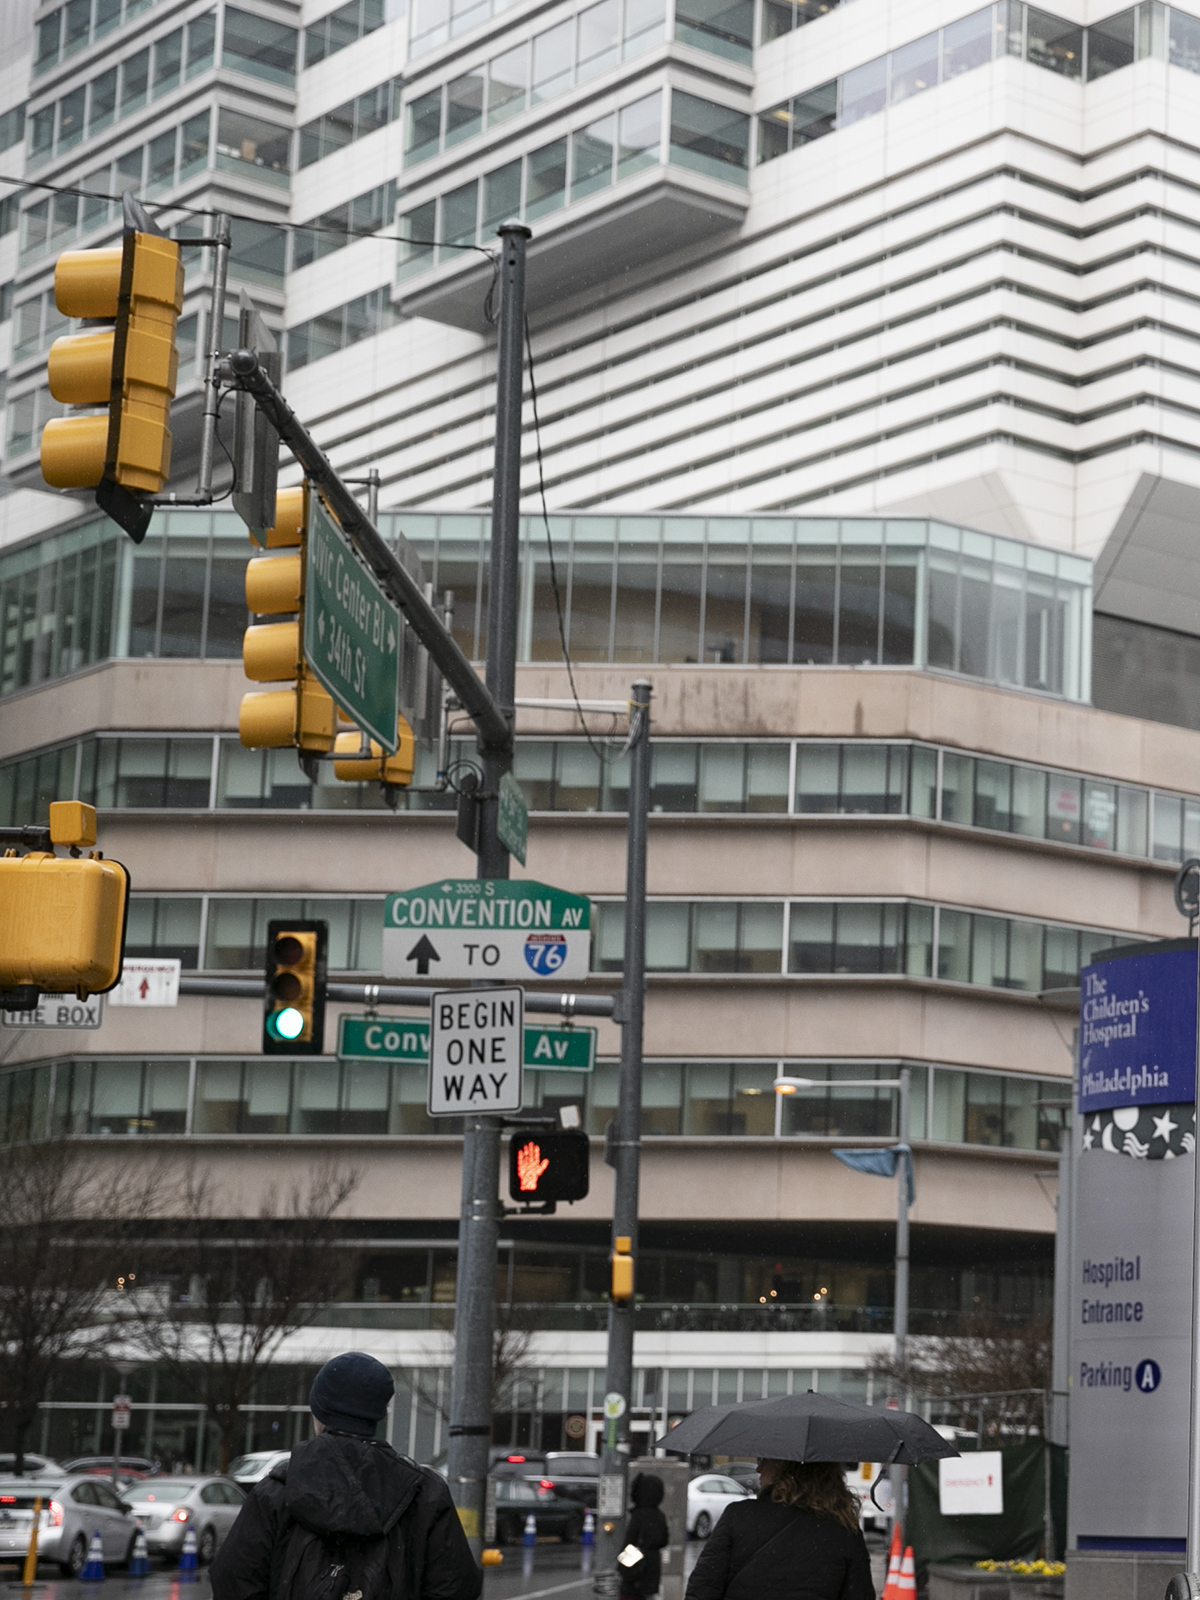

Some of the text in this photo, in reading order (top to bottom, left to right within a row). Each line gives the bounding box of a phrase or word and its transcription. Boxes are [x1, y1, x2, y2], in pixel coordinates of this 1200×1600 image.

[312, 514, 386, 653] Civic Center Bl
[327, 615, 367, 699] 34th St
[484, 882, 495, 896] S
[392, 897, 583, 927] CONVENTION AV
[463, 944, 562, 969] TO 76
[1084, 973, 1107, 997] The
[57, 1006, 96, 1024] BOX
[440, 1000, 515, 1030] BEGIN
[1083, 990, 1149, 1022] Children's
[1083, 1014, 1136, 1048] Hospital
[446, 1037, 506, 1066] ONE
[533, 1035, 569, 1060] Av
[443, 1072, 508, 1101] WAY
[1082, 1065, 1169, 1097] Philadelphia
[1083, 1255, 1140, 1288] Hospital
[1082, 1299, 1143, 1324] Entrance
[1080, 1361, 1155, 1392] Parking A
